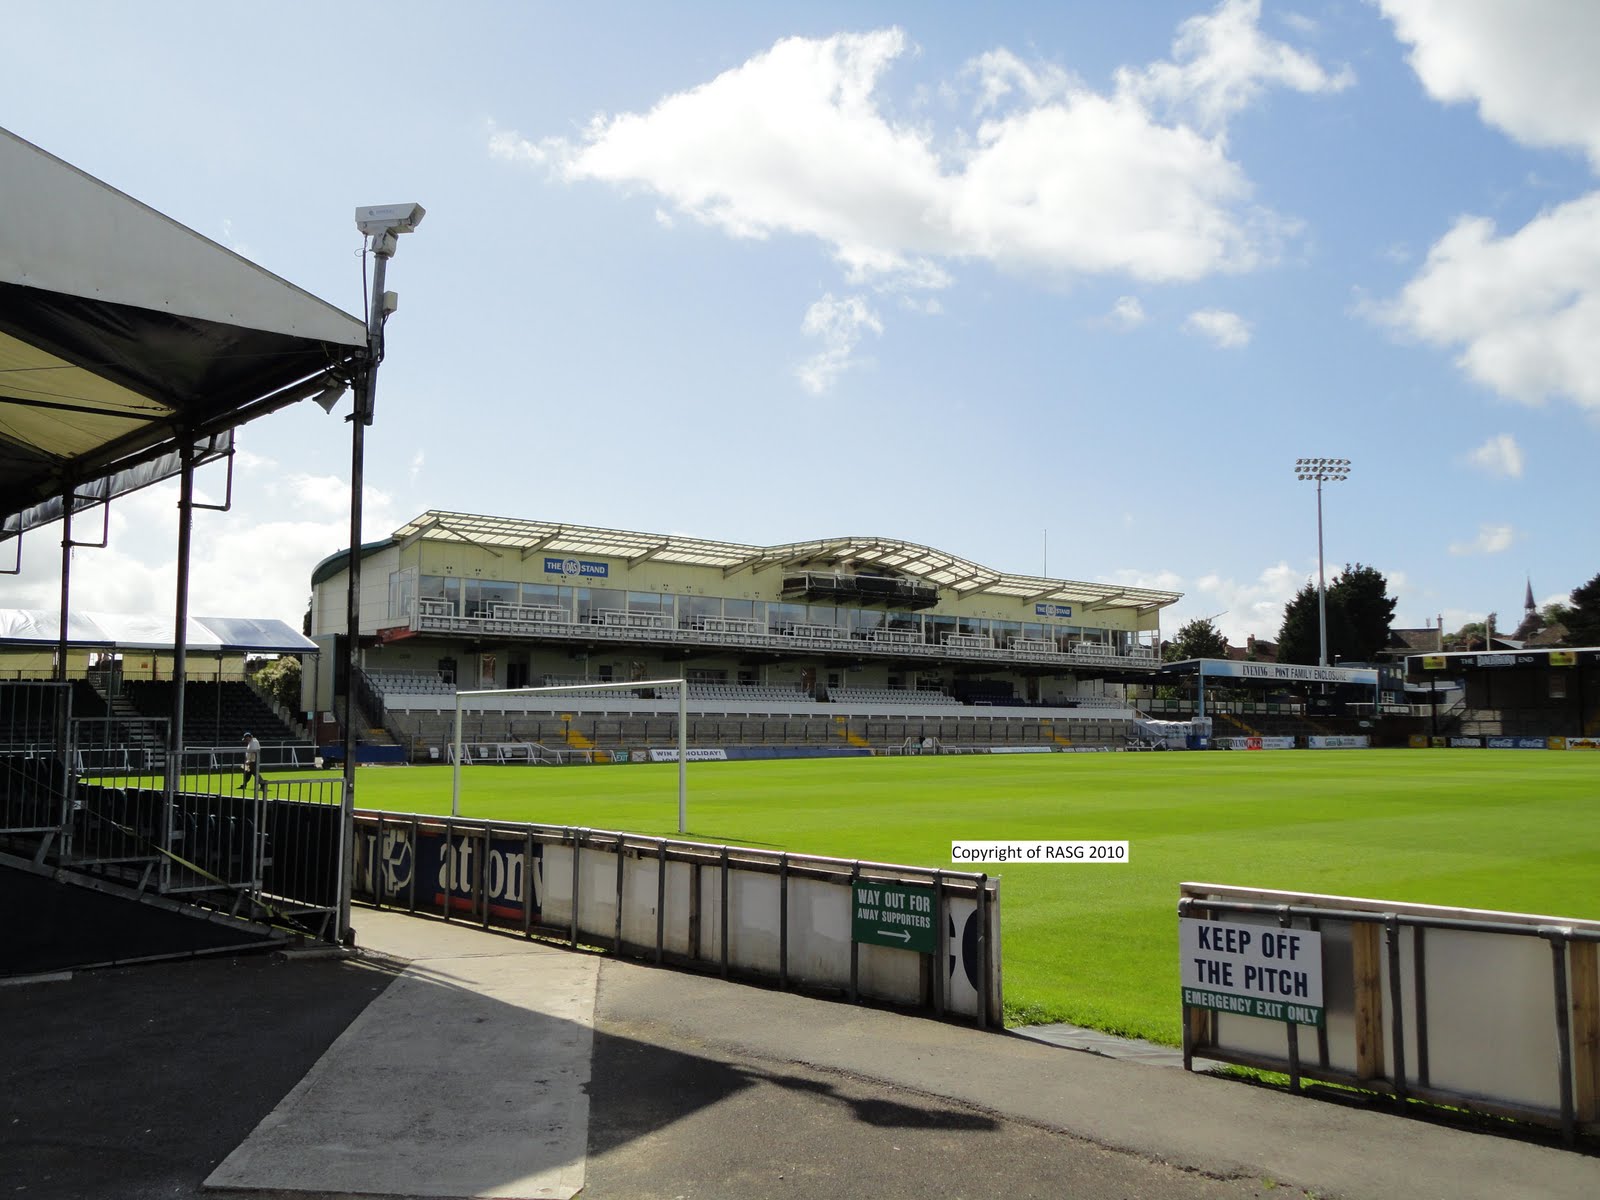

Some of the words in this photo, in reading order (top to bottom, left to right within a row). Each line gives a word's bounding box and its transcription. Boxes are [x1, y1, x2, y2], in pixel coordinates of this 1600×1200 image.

[581, 565, 605, 574] STAND
[1242, 665, 1268, 676] EVENING
[1275, 667, 1289, 678] POST
[1291, 668, 1312, 679] FAMILY
[1314, 670, 1347, 681] ENCLOSURE
[857, 889, 880, 906] WAY
[885, 891, 905, 910] OUT
[909, 895, 930, 913] FOR
[857, 908, 879, 921] AWAY
[881, 910, 931, 929] SUPPORTERS
[1198, 925, 1251, 955] KEEP
[1261, 932, 1300, 961] OFF
[1194, 958, 1233, 987] THE
[1244, 965, 1308, 998] PITCH
[1185, 990, 1251, 1013] EMERGENCY
[1256, 1001, 1283, 1018] EXIT
[1287, 1005, 1318, 1024] ONLY
